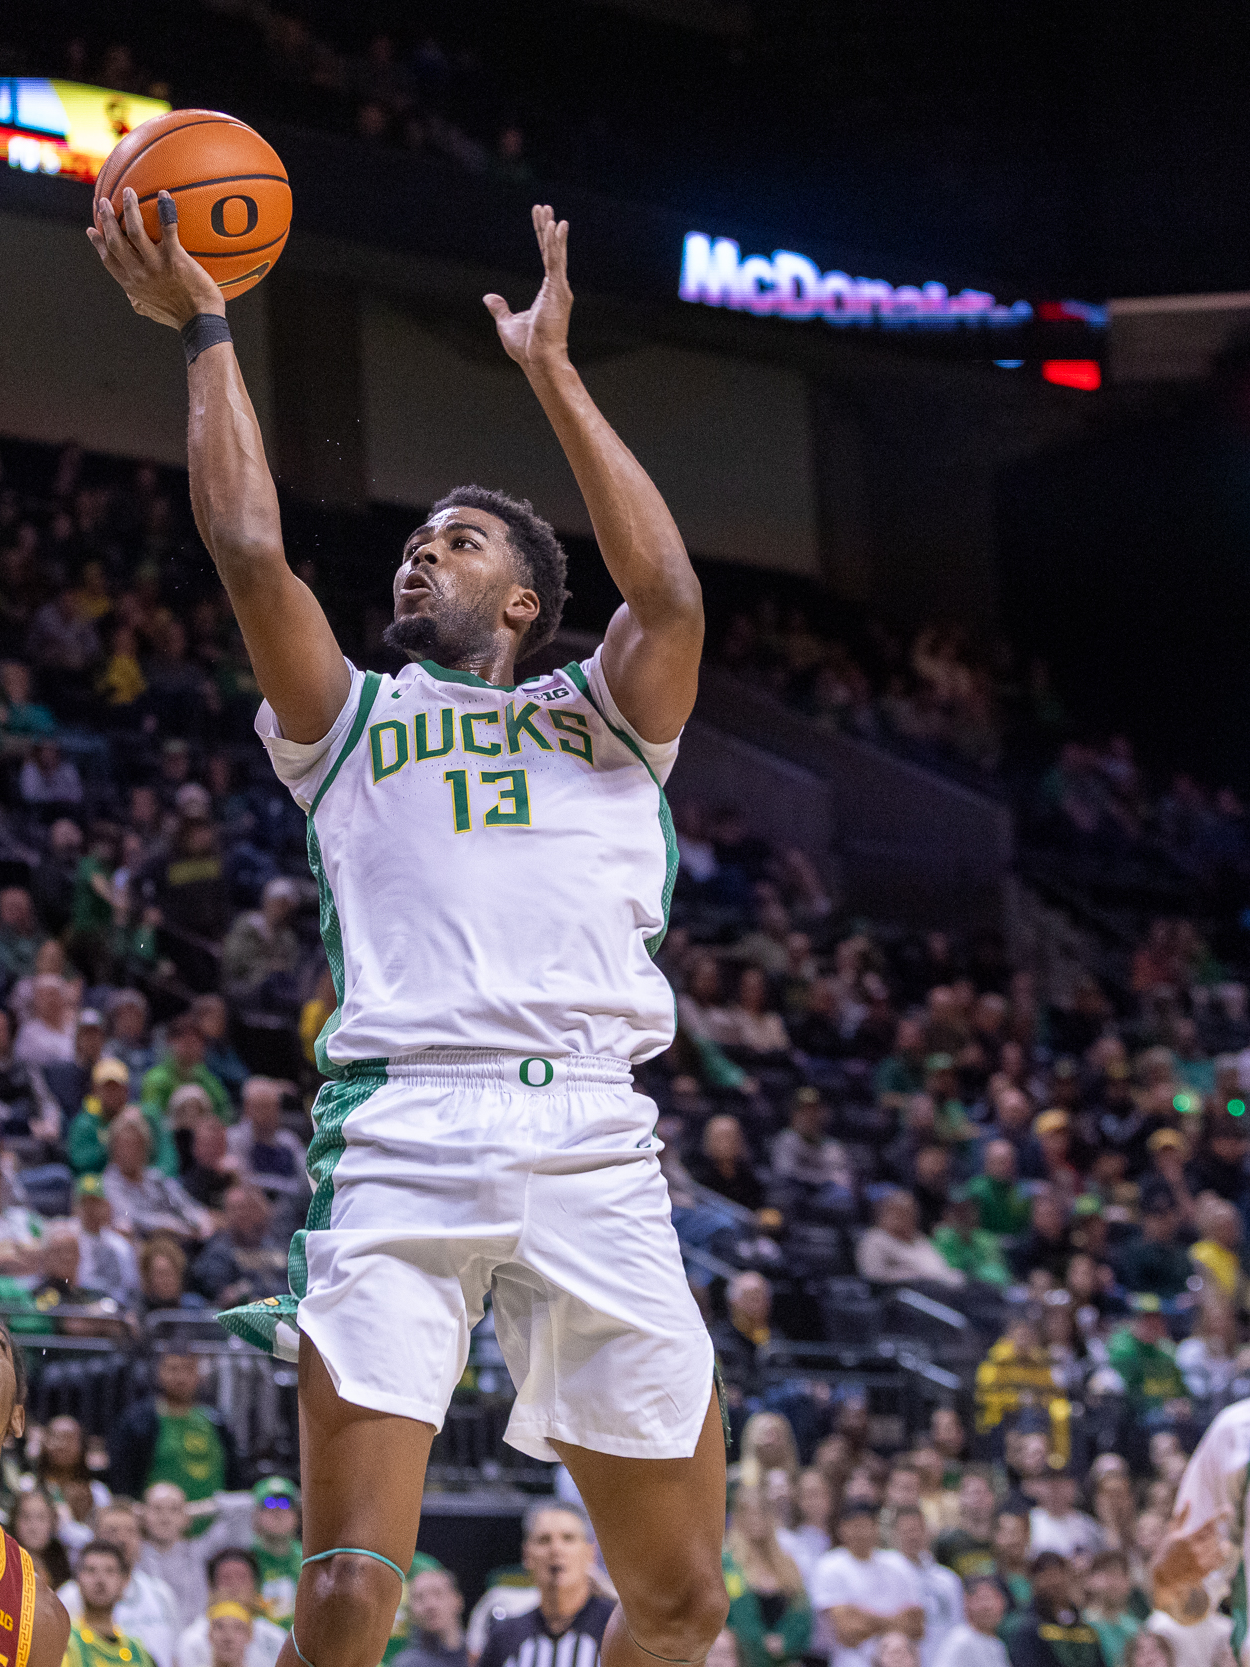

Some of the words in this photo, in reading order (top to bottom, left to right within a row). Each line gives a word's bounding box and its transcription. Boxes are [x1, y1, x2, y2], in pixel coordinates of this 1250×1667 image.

[211, 195, 258, 237] O
[368, 700, 594, 786] DUCKS
[443, 768, 532, 834] 13
[519, 1057, 554, 1087] O
